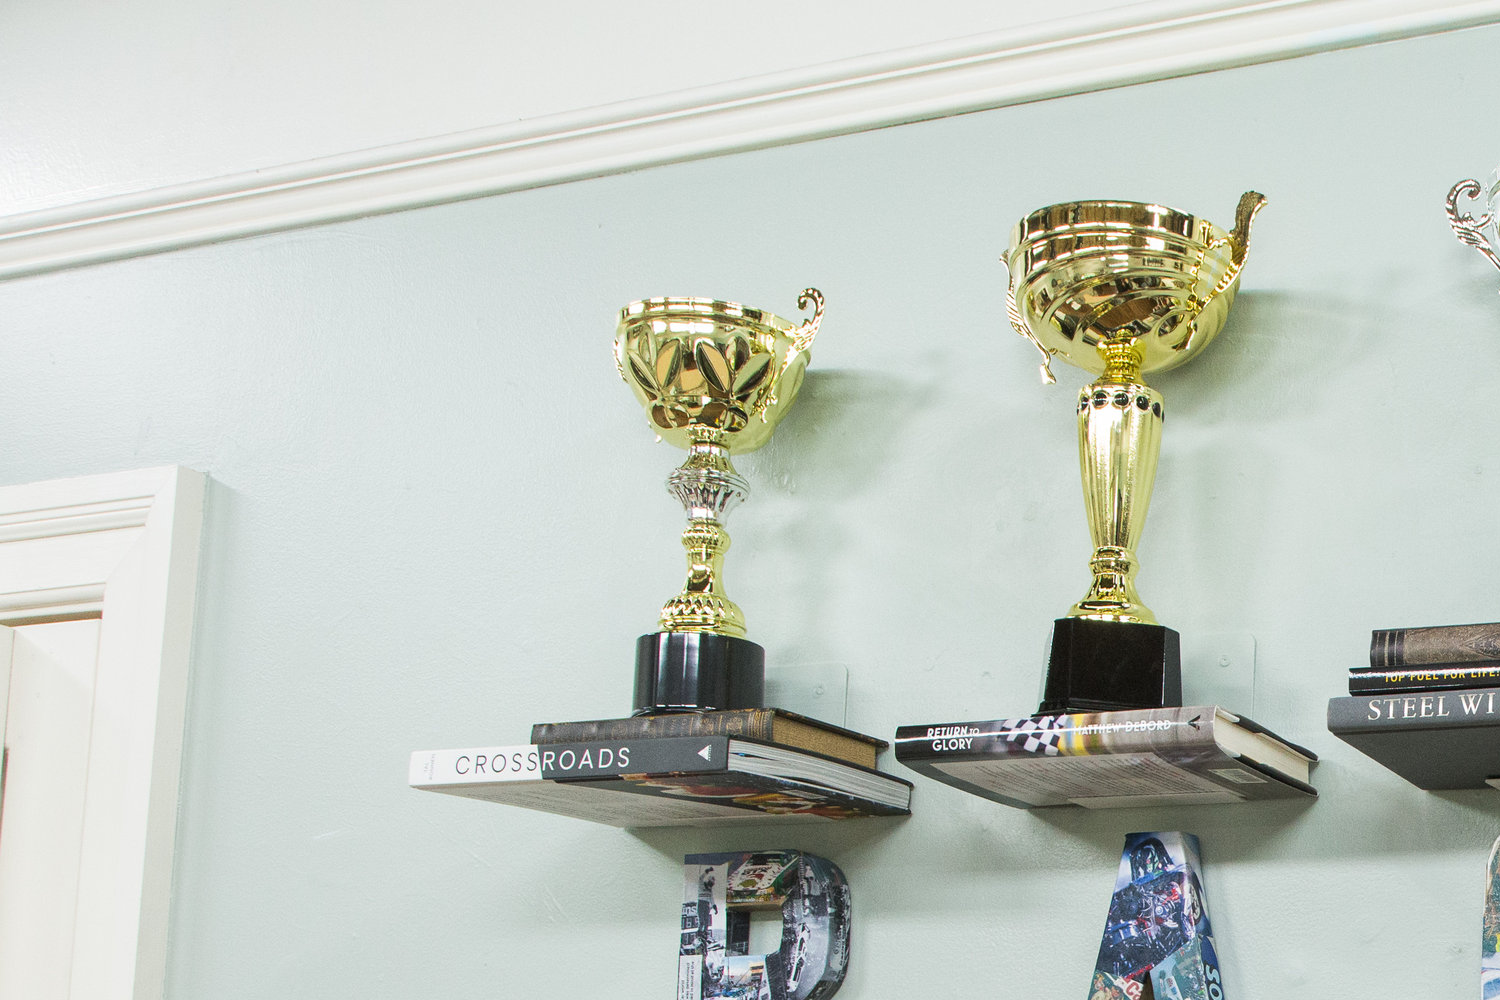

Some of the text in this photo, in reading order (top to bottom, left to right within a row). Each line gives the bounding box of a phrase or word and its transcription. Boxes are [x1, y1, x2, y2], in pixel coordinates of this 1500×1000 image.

[1367, 693, 1450, 721] STEEL
[927, 725, 969, 740] RETURN
[932, 738, 973, 751] GLORY
[455, 746, 631, 775] CROSSROADS
